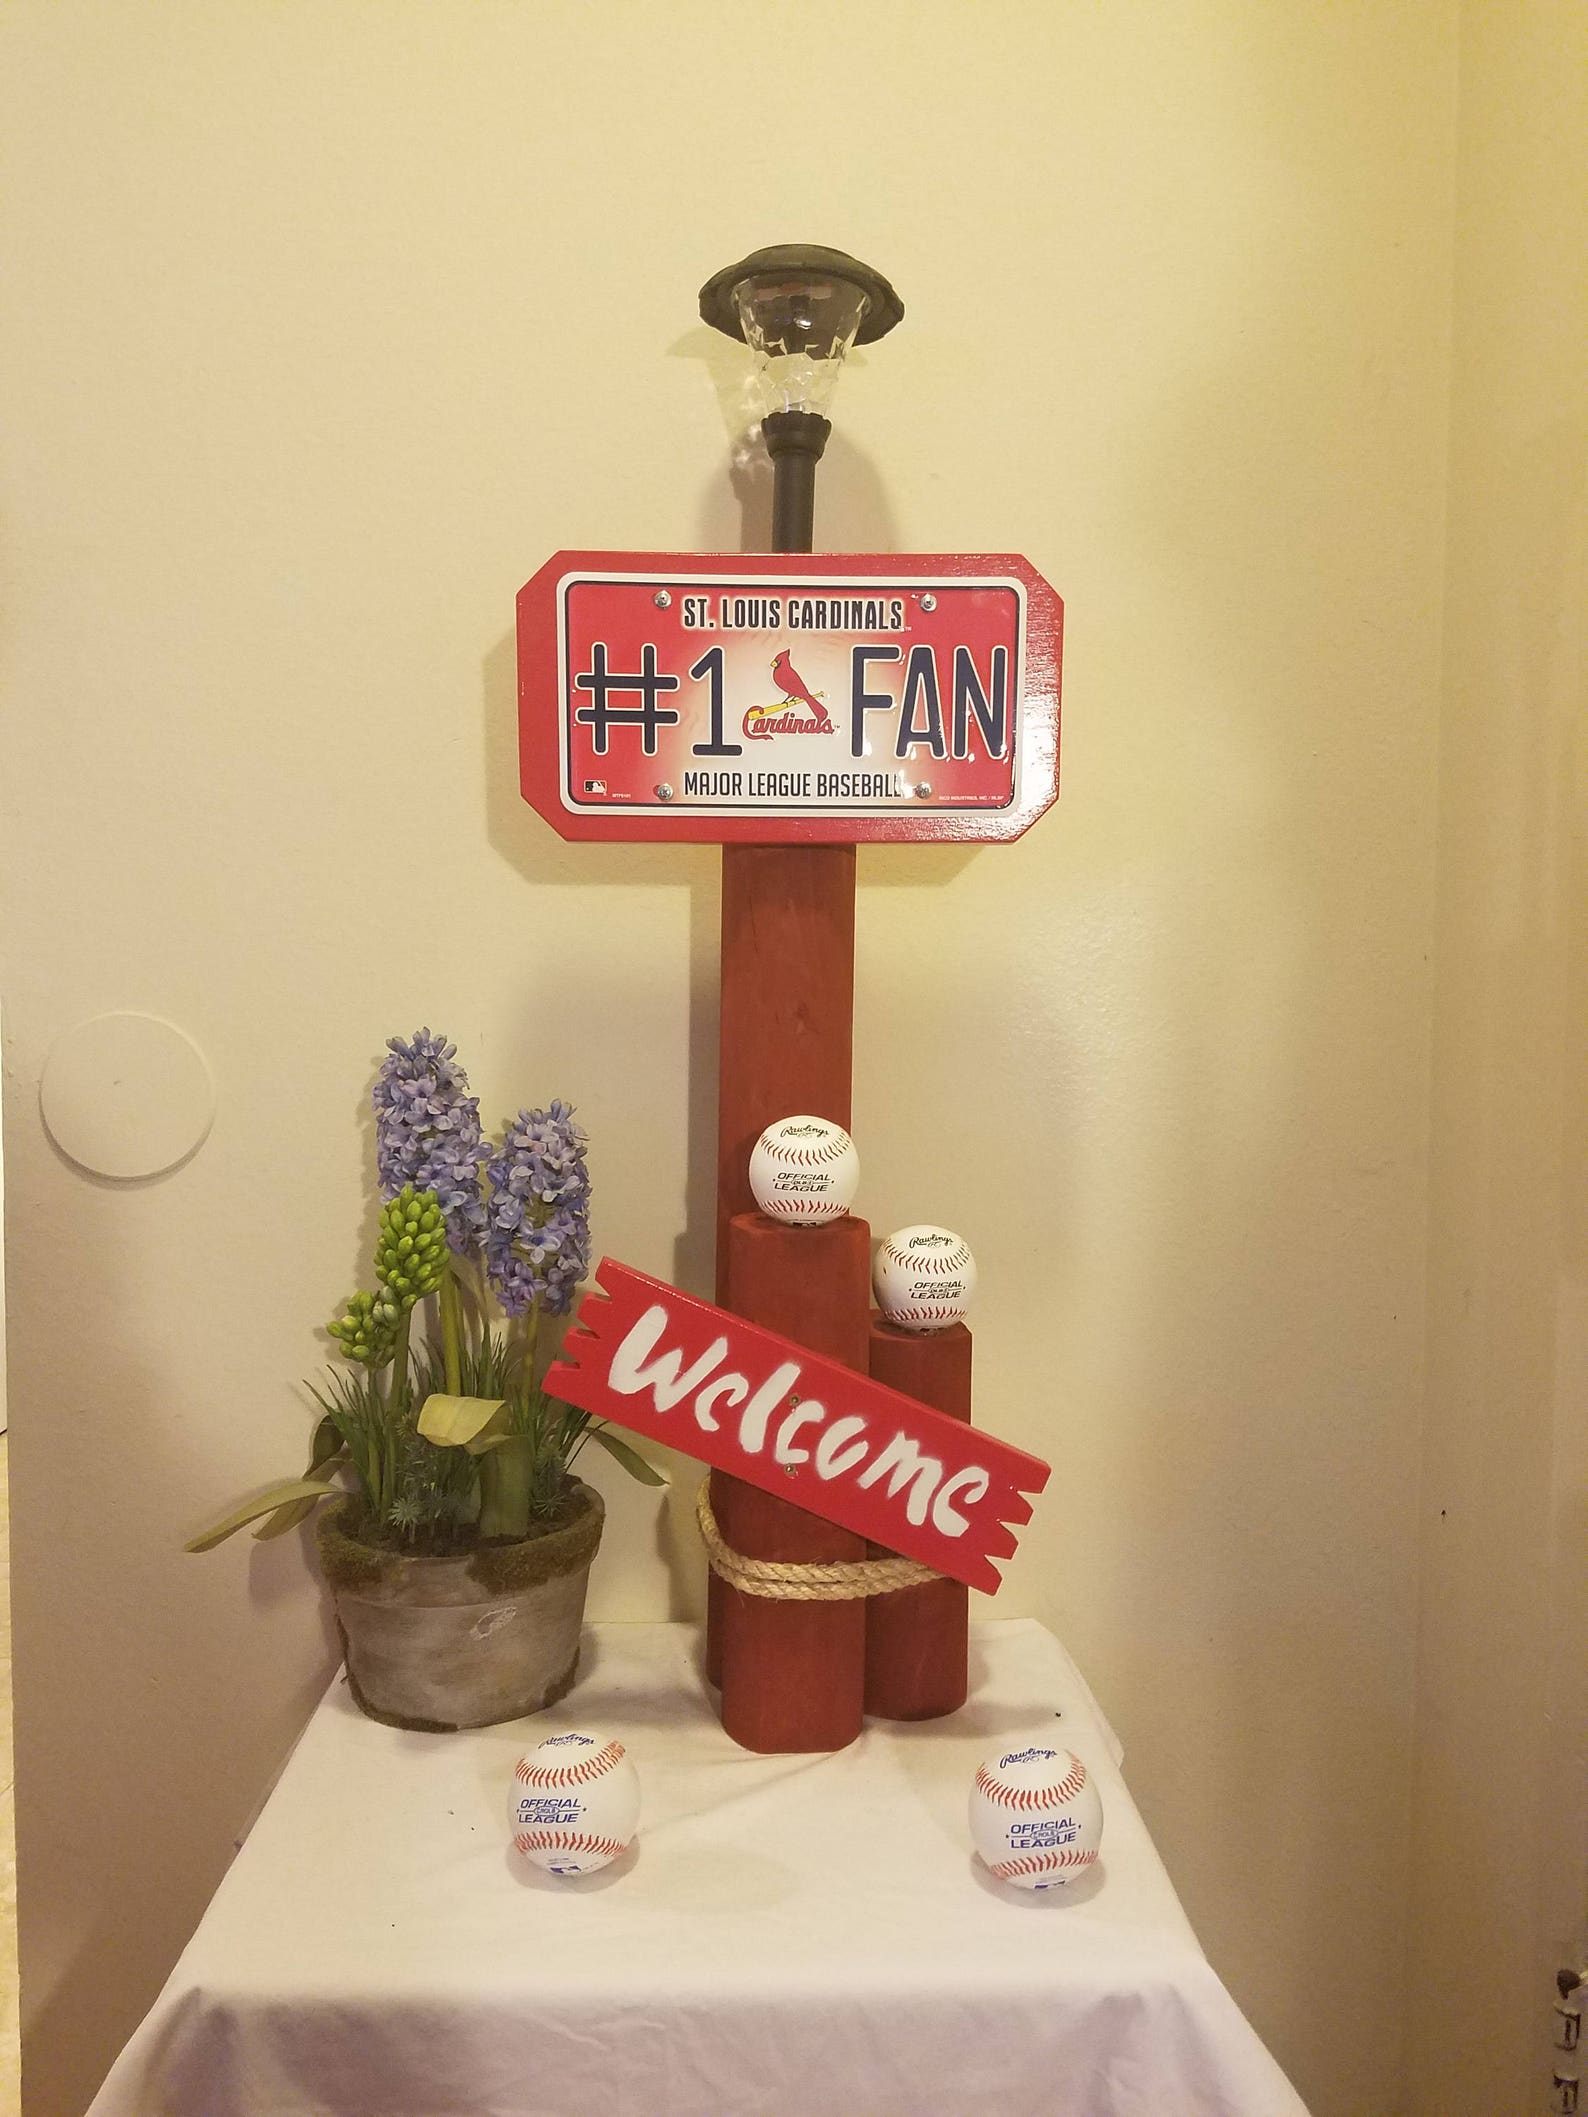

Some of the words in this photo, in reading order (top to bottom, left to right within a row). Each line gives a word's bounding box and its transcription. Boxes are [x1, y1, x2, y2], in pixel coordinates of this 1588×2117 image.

[683, 598, 714, 628] ST.
[722, 598, 780, 629] LOUIS
[788, 600, 902, 630] CARDINALS
[851, 646, 1008, 759] FAN
[742, 705, 835, 741] Cardinals
[684, 772, 742, 796] MAJOR
[748, 773, 811, 797] LEAGUE
[816, 773, 902, 798] BASEBALL
[780, 1124, 829, 1138] Rawlings
[777, 1172, 831, 1181] OFFICIAL
[774, 1183, 829, 1192] LEAGUE
[909, 1233, 953, 1248] Rawlings
[914, 1280, 963, 1290] OFFICIAL
[910, 1290, 962, 1300] LEAGUE
[607, 1304, 990, 1538] Welcome
[1000, 1747, 1057, 1769] Rawlings
[520, 1798, 581, 1809] OFFICIAL
[518, 1813, 579, 1824] LEAGUE
[1010, 1817, 1076, 1834] OFFICIAL
[1010, 1831, 1076, 1849] LEAGUE
